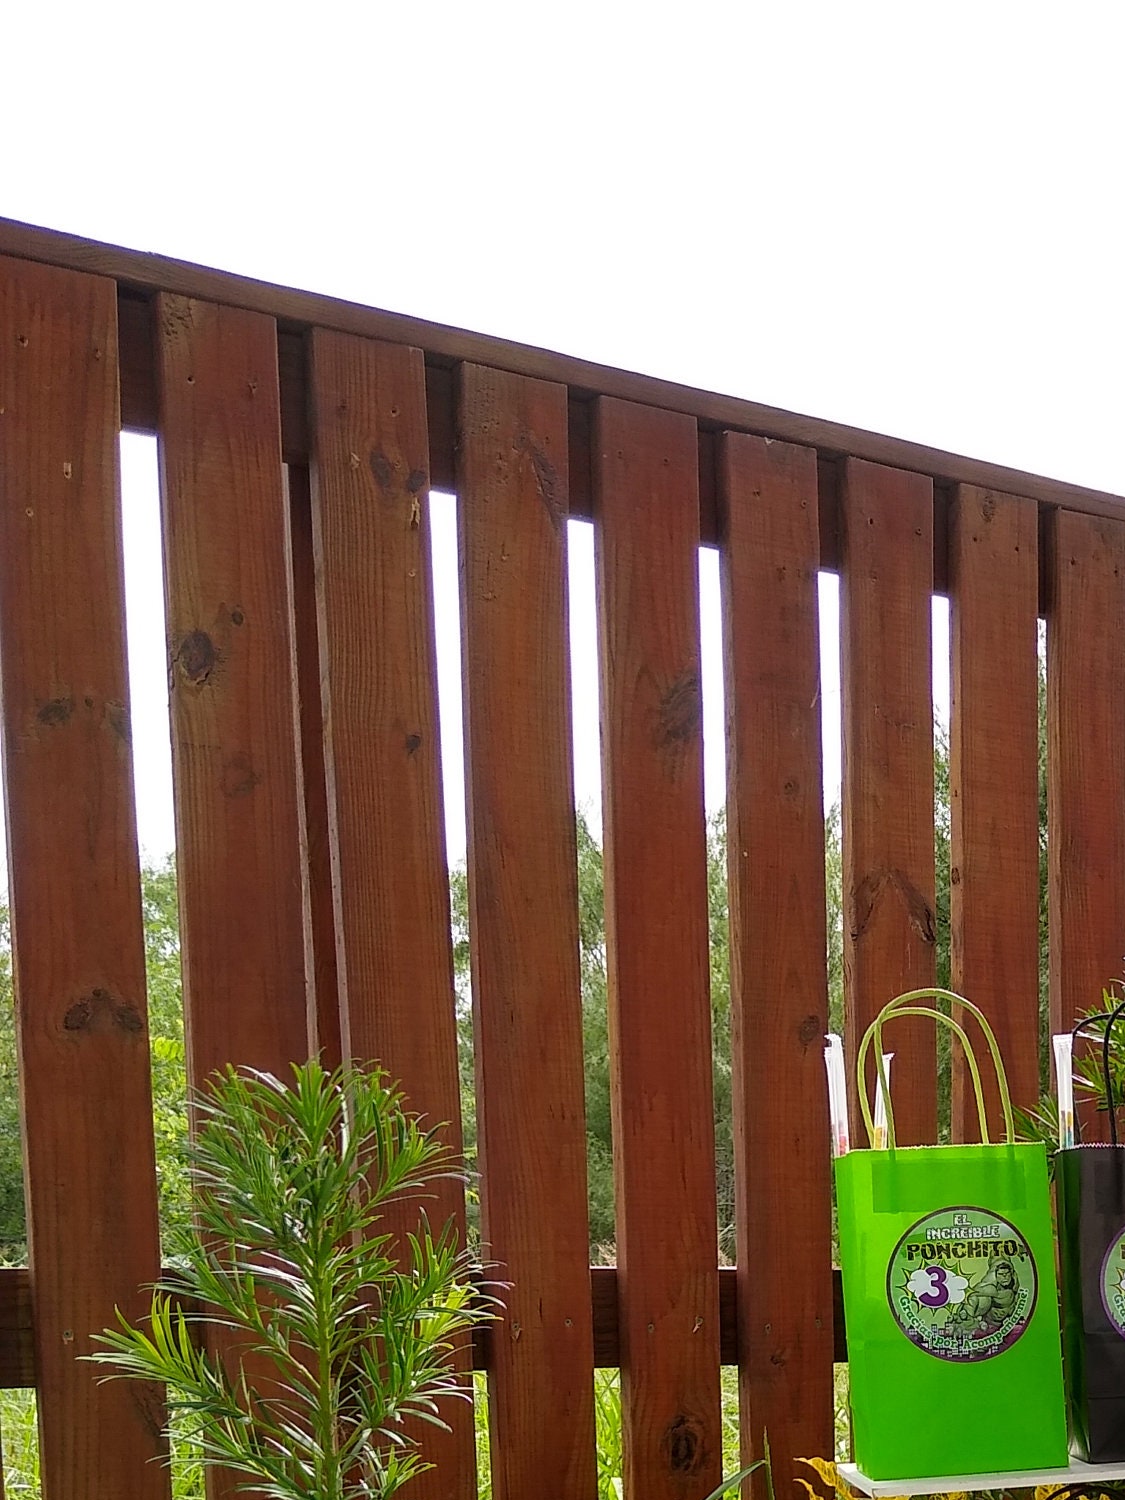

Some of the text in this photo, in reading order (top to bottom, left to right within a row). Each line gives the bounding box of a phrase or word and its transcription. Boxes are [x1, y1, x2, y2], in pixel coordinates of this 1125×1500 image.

[953, 1214, 971, 1225] EL
[927, 1226, 999, 1240] INCREIBLE
[907, 1240, 1018, 1260] PONCHITO
[919, 1266, 948, 1306] 3
[900, 1288, 1028, 1349] Gracias por Acompañarme!
